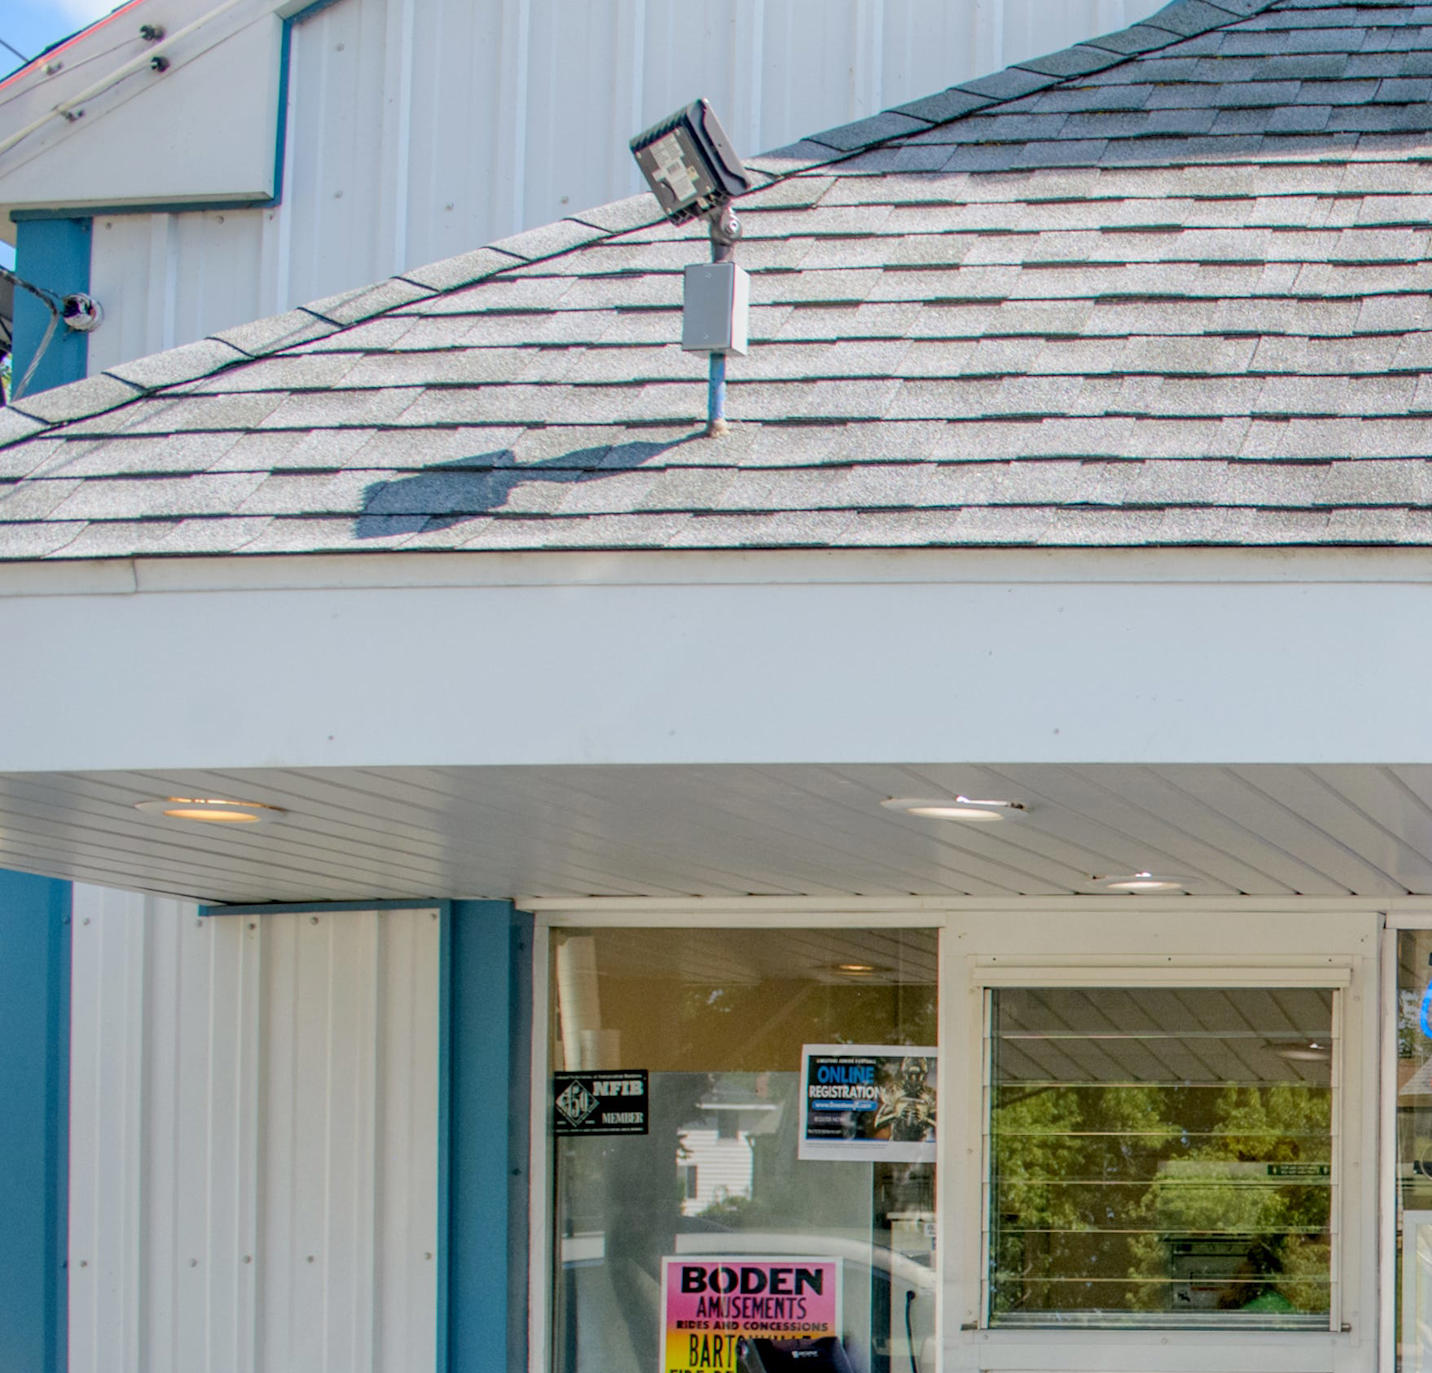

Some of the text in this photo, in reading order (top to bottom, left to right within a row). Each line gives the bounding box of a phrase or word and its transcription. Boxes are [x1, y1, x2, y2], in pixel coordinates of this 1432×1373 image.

[817, 1065, 875, 1084] ONLINE
[808, 1084, 884, 1099] REGISTRATION
[602, 1111, 644, 1124] MEMBER
[681, 1266, 823, 1296] BODEN
[696, 1296, 807, 1320] AMUSEMENTS
[676, 1320, 829, 1332] RIDES AND CONCESSIONS
